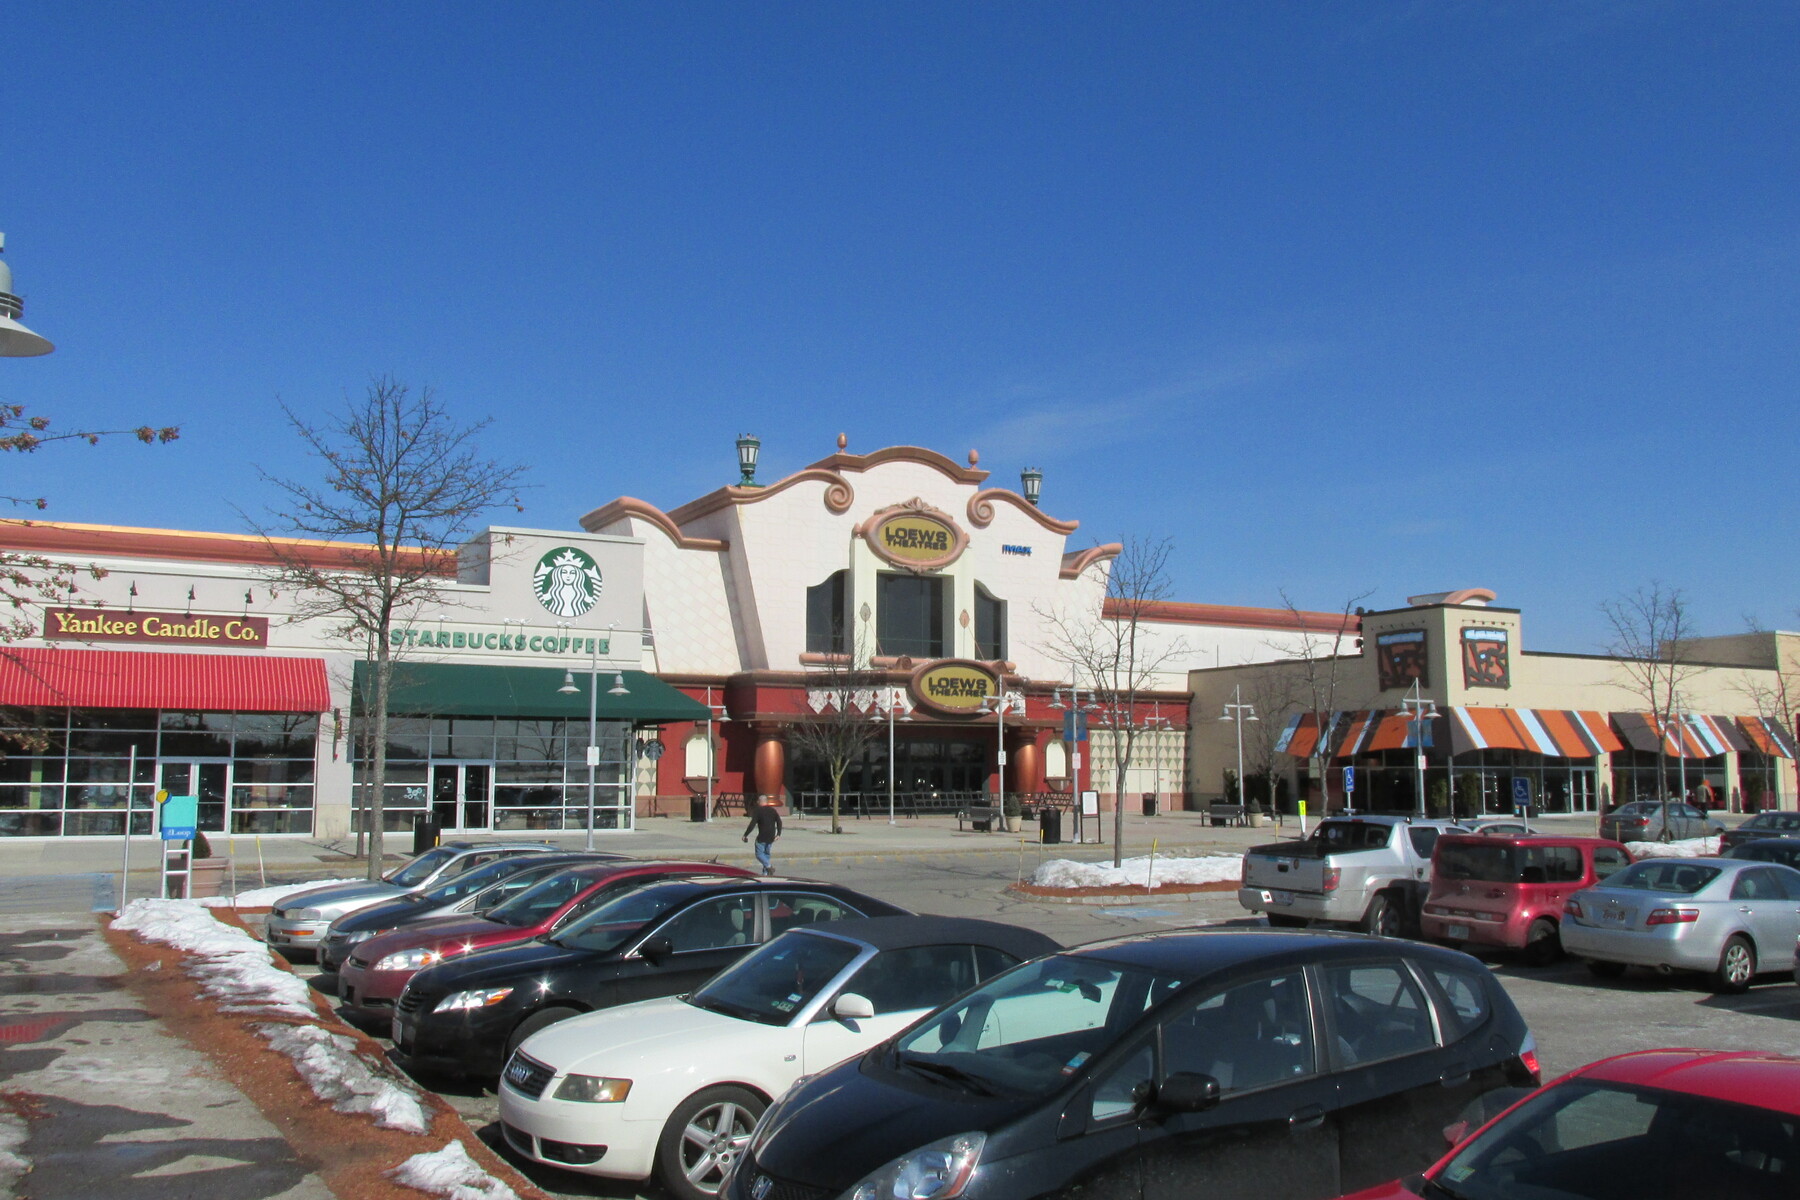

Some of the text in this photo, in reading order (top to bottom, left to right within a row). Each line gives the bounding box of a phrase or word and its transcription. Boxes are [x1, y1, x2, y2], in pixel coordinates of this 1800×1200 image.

[885, 527, 948, 542] LOEWS
[886, 538, 948, 551] THEATRES
[1001, 544, 1032, 556] IMAX
[54, 612, 259, 641] Yankee Candle Co.
[390, 628, 610, 655] STARBUCKS COFFEE
[928, 677, 987, 690] LOEWS
[929, 688, 987, 698] THEATRES
